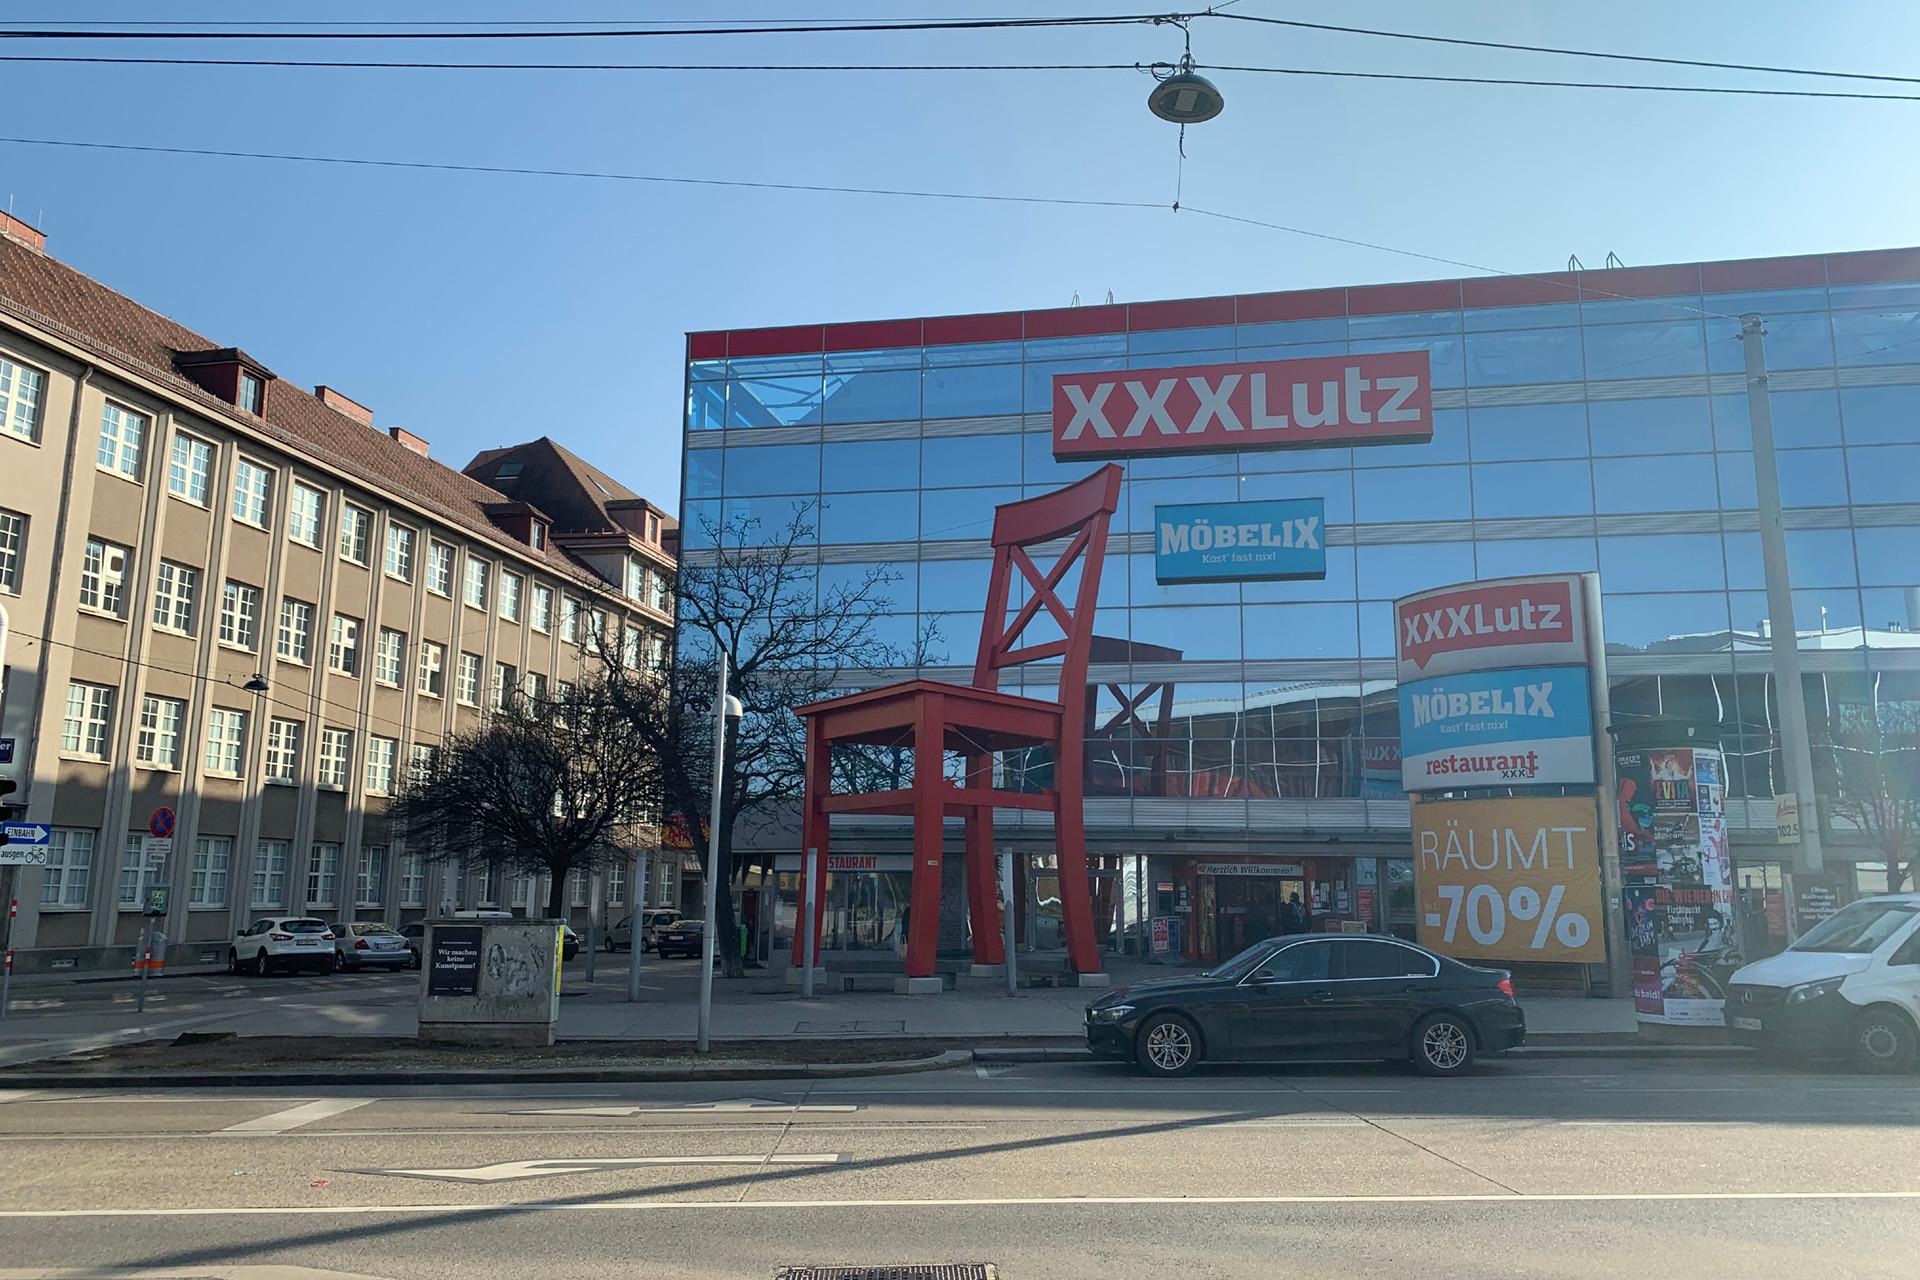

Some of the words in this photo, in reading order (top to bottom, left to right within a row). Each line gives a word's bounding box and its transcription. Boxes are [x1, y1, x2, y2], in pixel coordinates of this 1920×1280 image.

[1060, 367, 1421, 440] XXXLutz
[1160, 516, 1319, 556] MÖBELIX
[1232, 552, 1253, 562] fast
[1404, 599, 1563, 647] XXXLutz
[1411, 681, 1555, 728] MÖBELIX
[1464, 721, 1486, 732] fast
[1426, 751, 1538, 776] restaurant
[1778, 824, 1799, 837] 102.5
[1420, 819, 1586, 870] RÄUMT
[829, 856, 878, 869] STAURANT
[1206, 865, 1238, 874] Herzlich
[1425, 884, 1590, 949] -70%
[438, 948, 451, 956] Wir
